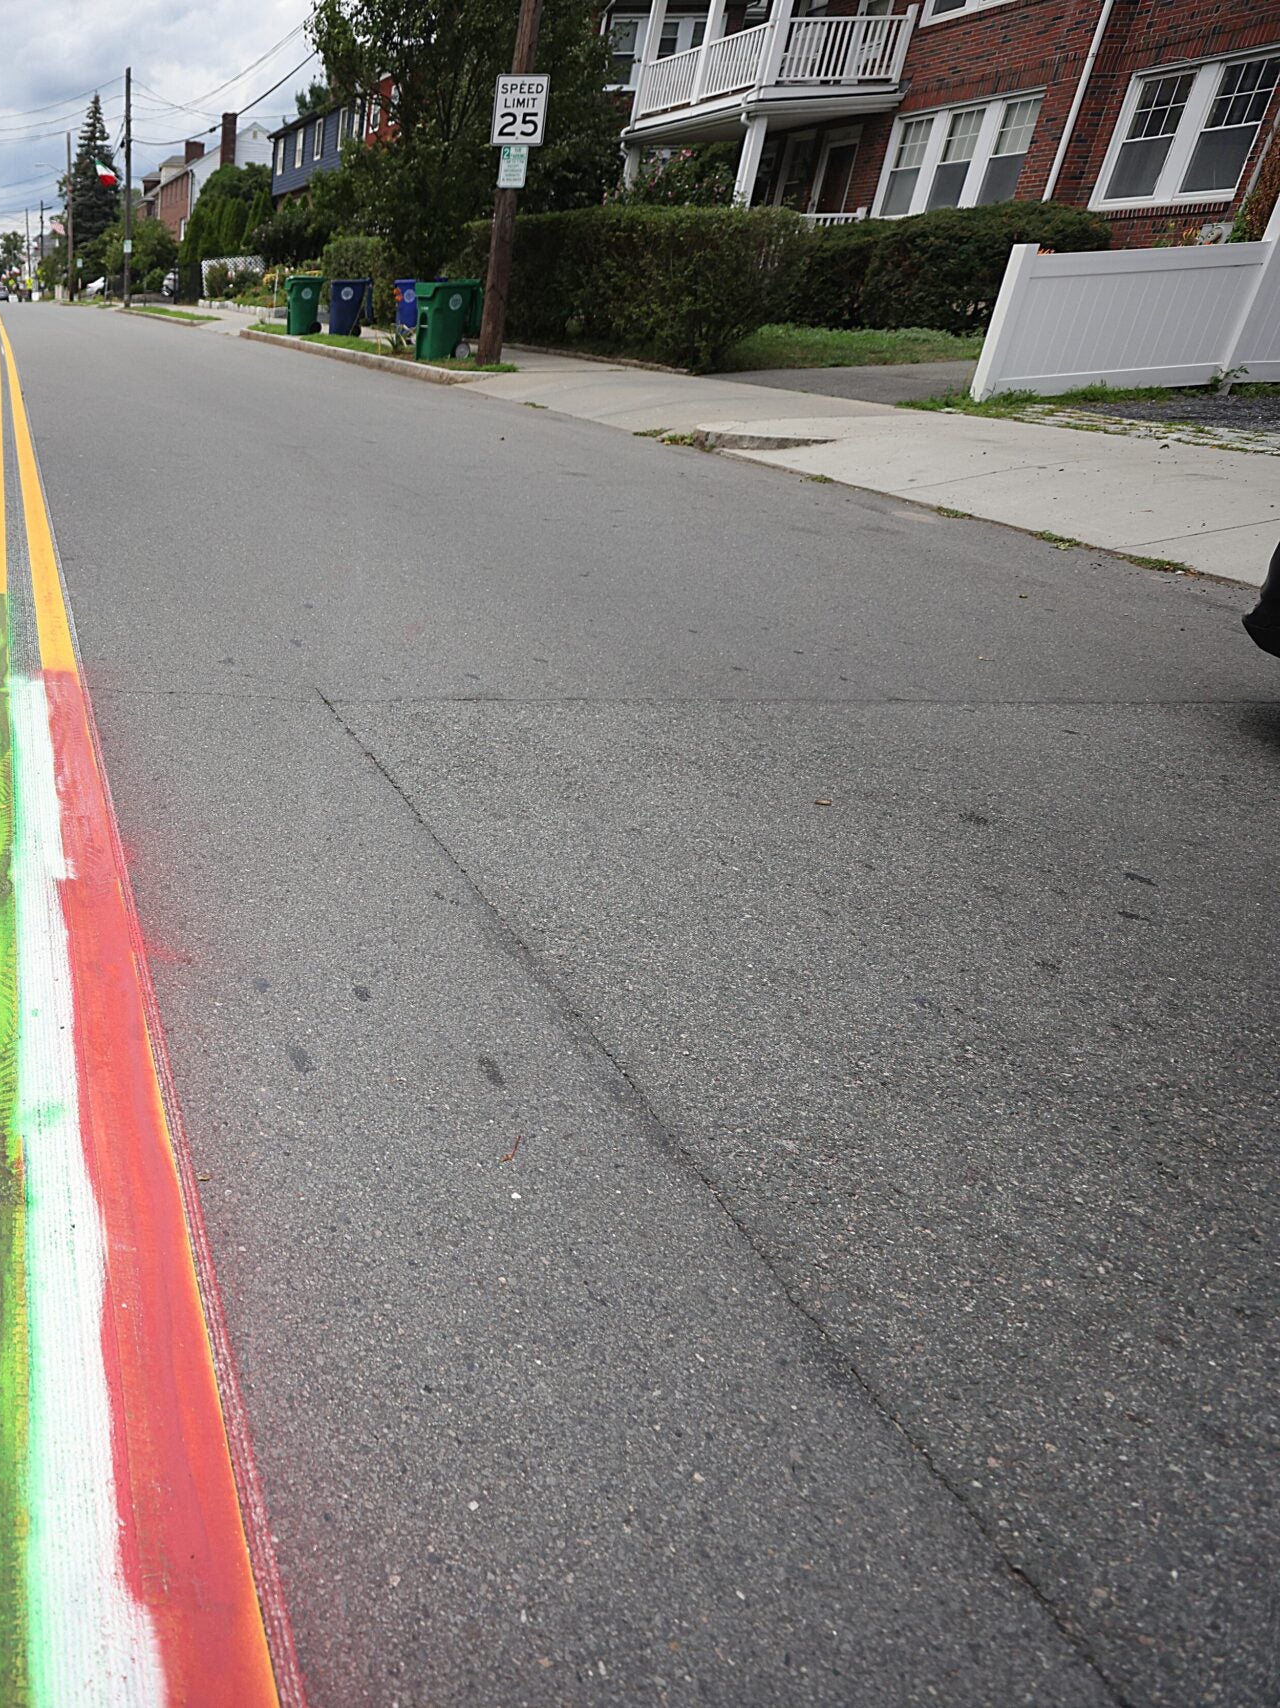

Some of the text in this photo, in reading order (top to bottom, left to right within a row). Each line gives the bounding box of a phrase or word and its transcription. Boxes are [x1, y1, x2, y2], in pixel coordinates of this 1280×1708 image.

[501, 83, 544, 94] SPEED
[504, 98, 538, 108] LIMIT
[498, 112, 539, 137] 25
[504, 148, 510, 158] 2
